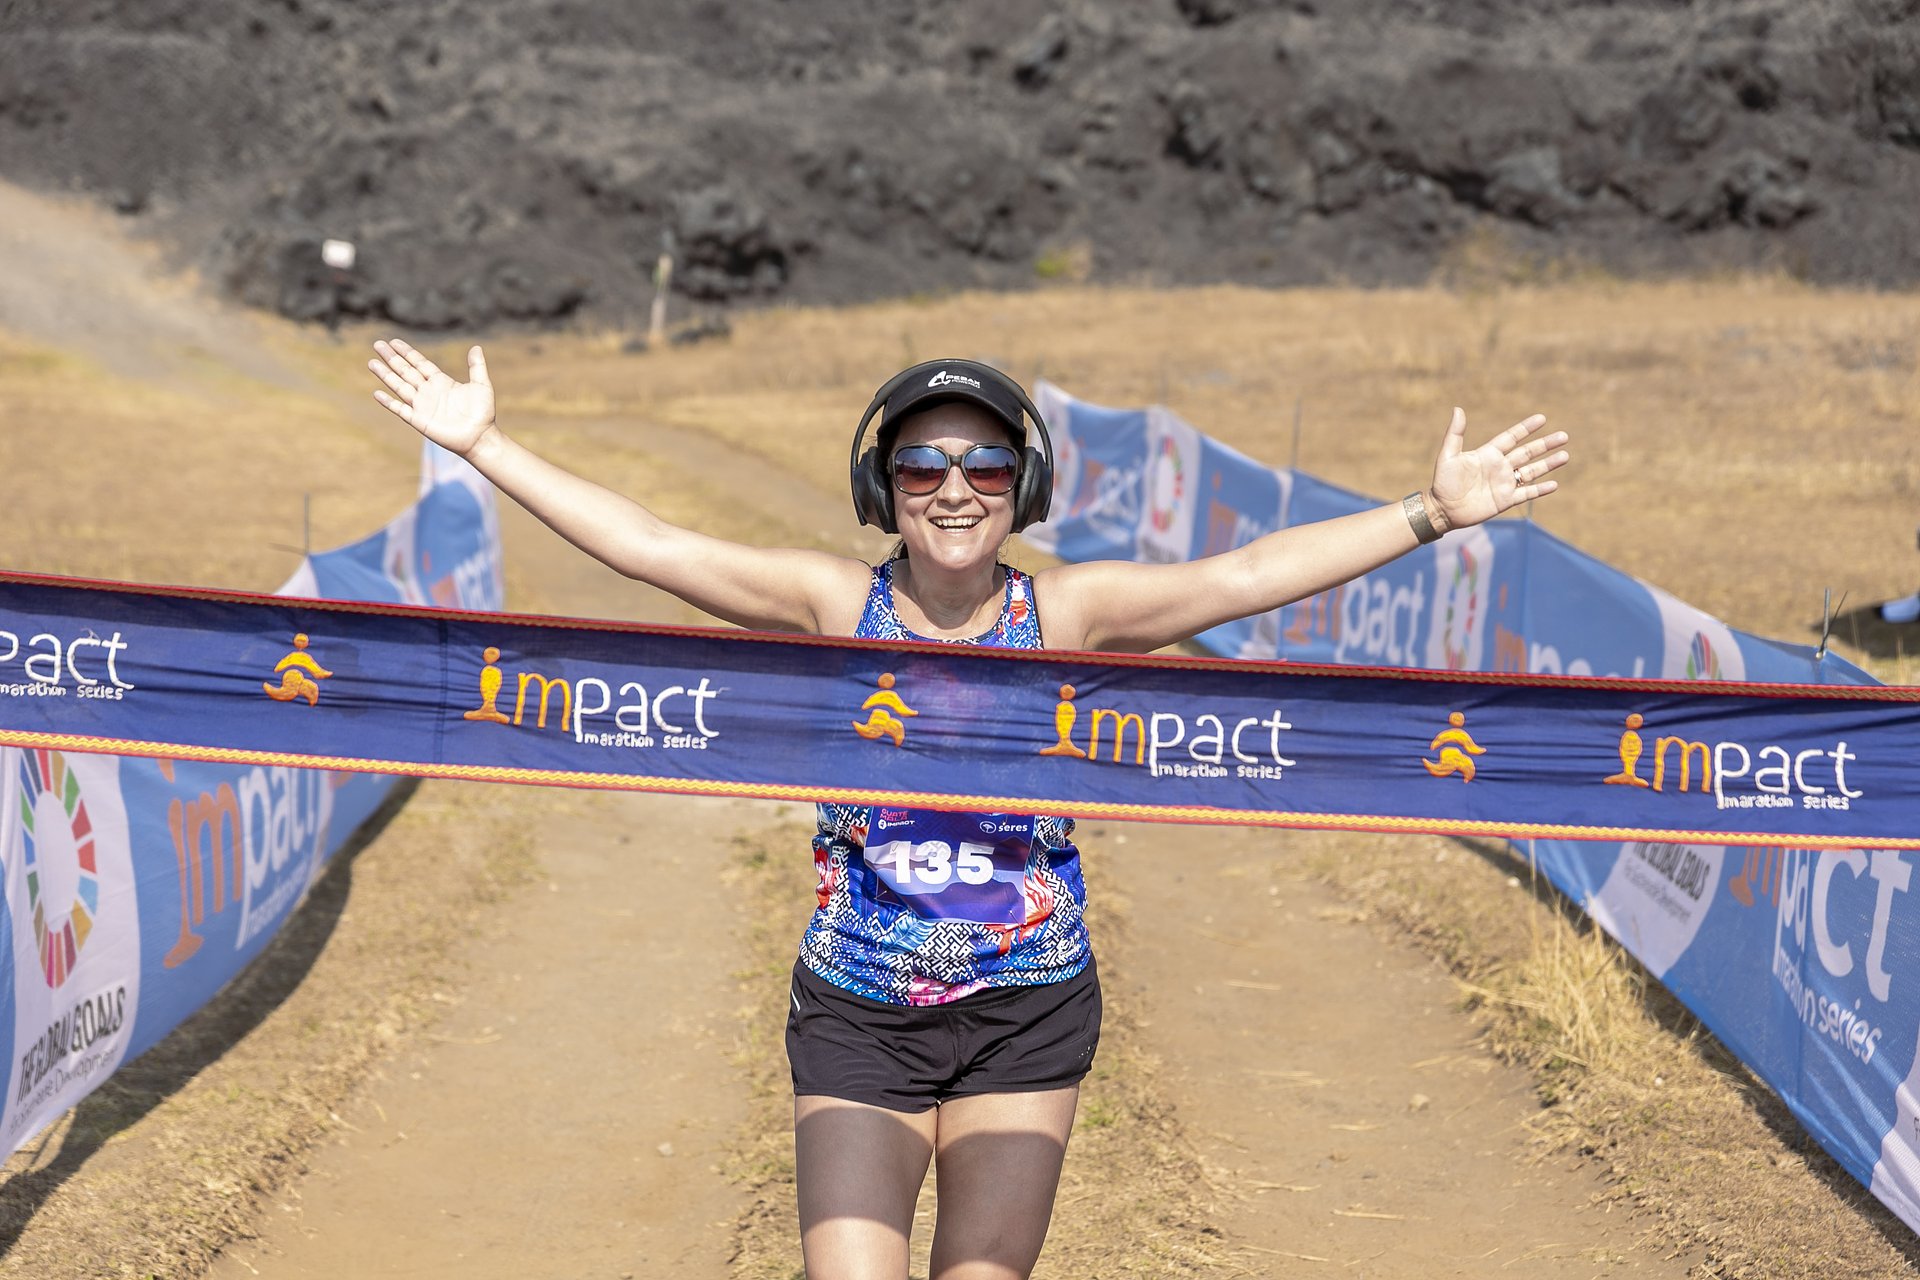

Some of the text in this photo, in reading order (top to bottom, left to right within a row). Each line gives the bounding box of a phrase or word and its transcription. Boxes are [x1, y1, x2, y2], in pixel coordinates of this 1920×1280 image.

[77, 685, 123, 700] series
[463, 646, 719, 743] impact
[584, 732, 708, 750] marathon series
[1039, 683, 1296, 777] impact
[1157, 763, 1282, 780] marathon series
[1603, 713, 1863, 810] impact
[1723, 795, 1850, 811] marathon series
[998, 824, 1028, 832] seres
[890, 840, 994, 885] 135
[71, 985, 126, 1052] GOALS
[1818, 996, 1882, 1065] series
